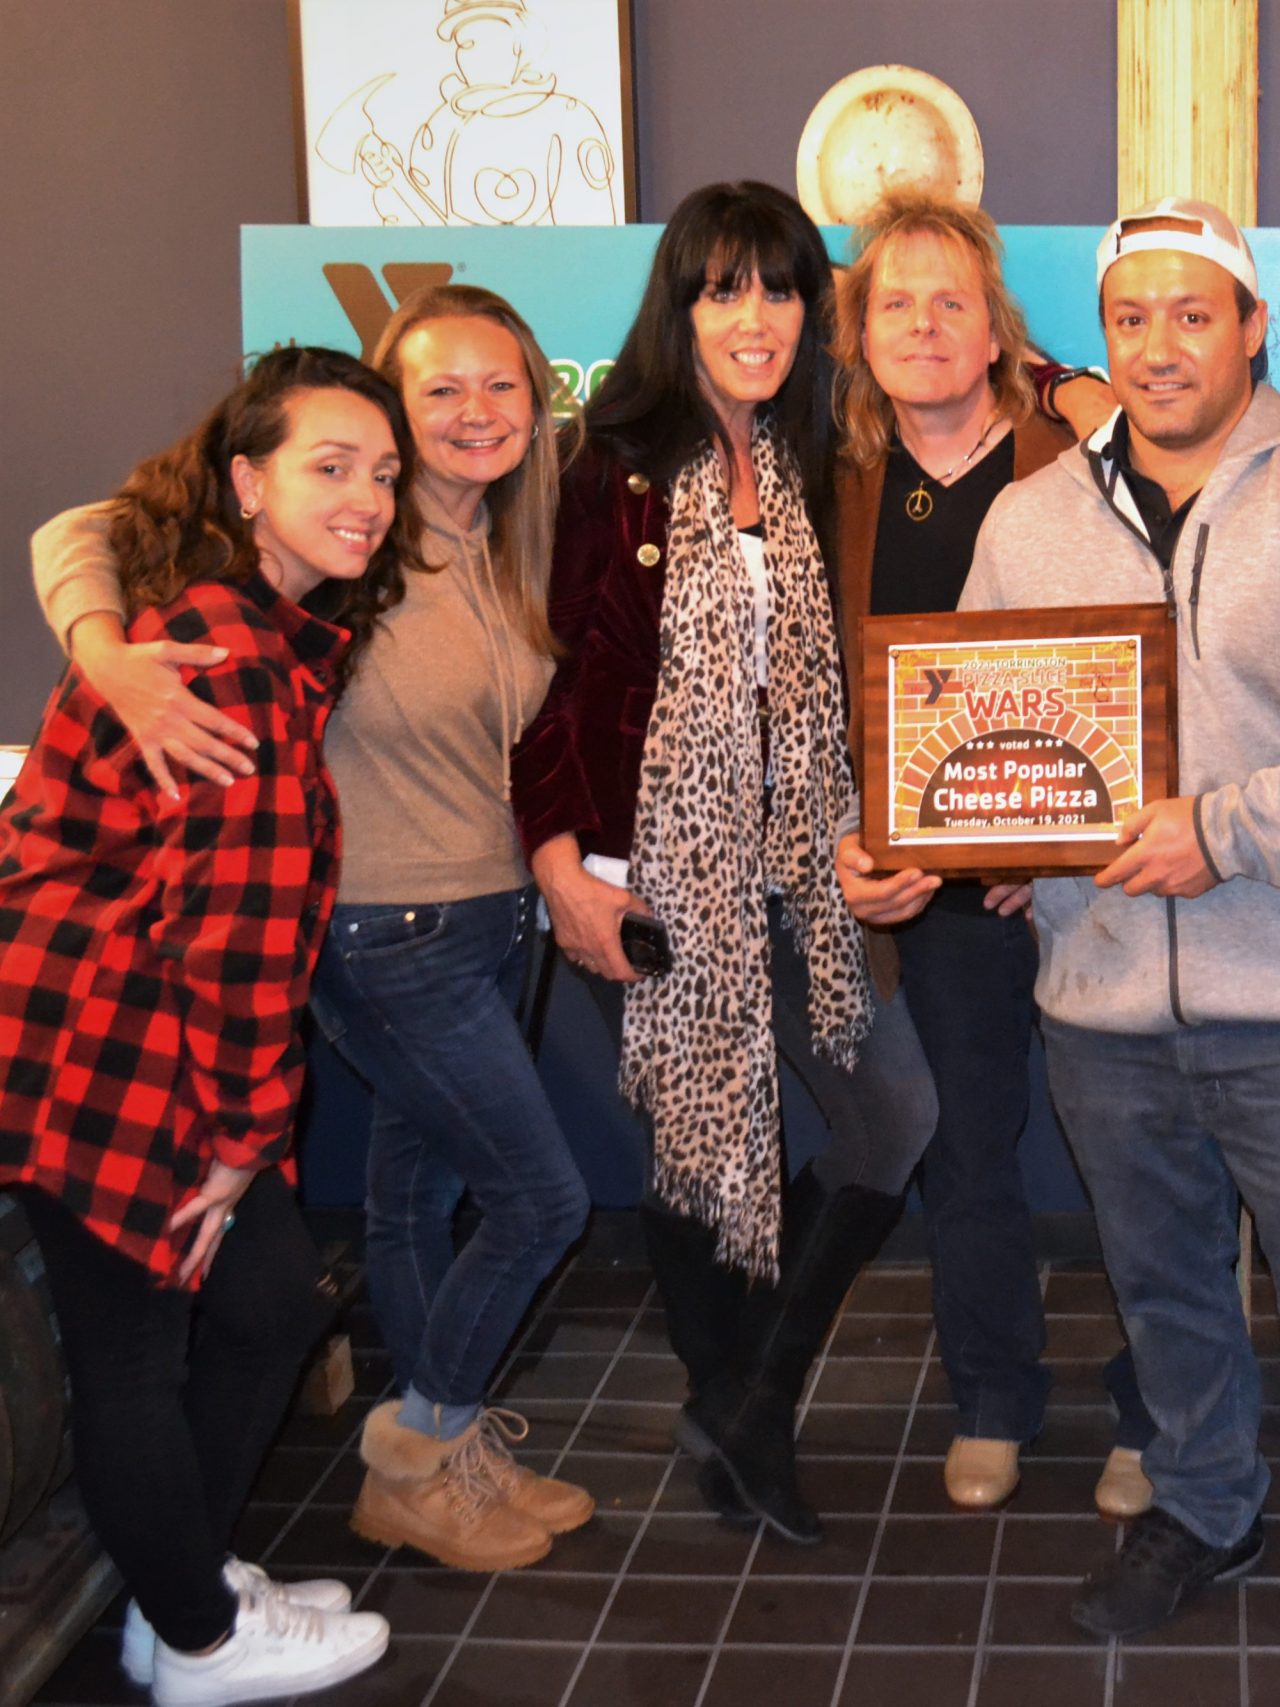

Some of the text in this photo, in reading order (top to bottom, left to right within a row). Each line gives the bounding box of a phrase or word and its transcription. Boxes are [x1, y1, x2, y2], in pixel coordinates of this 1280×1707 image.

[962, 671, 1015, 687] PIZZA
[1020, 669, 1066, 685] SLICE
[965, 688, 1065, 719] WARS
[999, 739, 1030, 750] voted
[944, 758, 1087, 784] Most Popular
[933, 786, 1098, 811] Cheese Pizza
[944, 817, 991, 828] Tuesday,
[993, 815, 1035, 827] October
[1058, 814, 1086, 824] 2021
